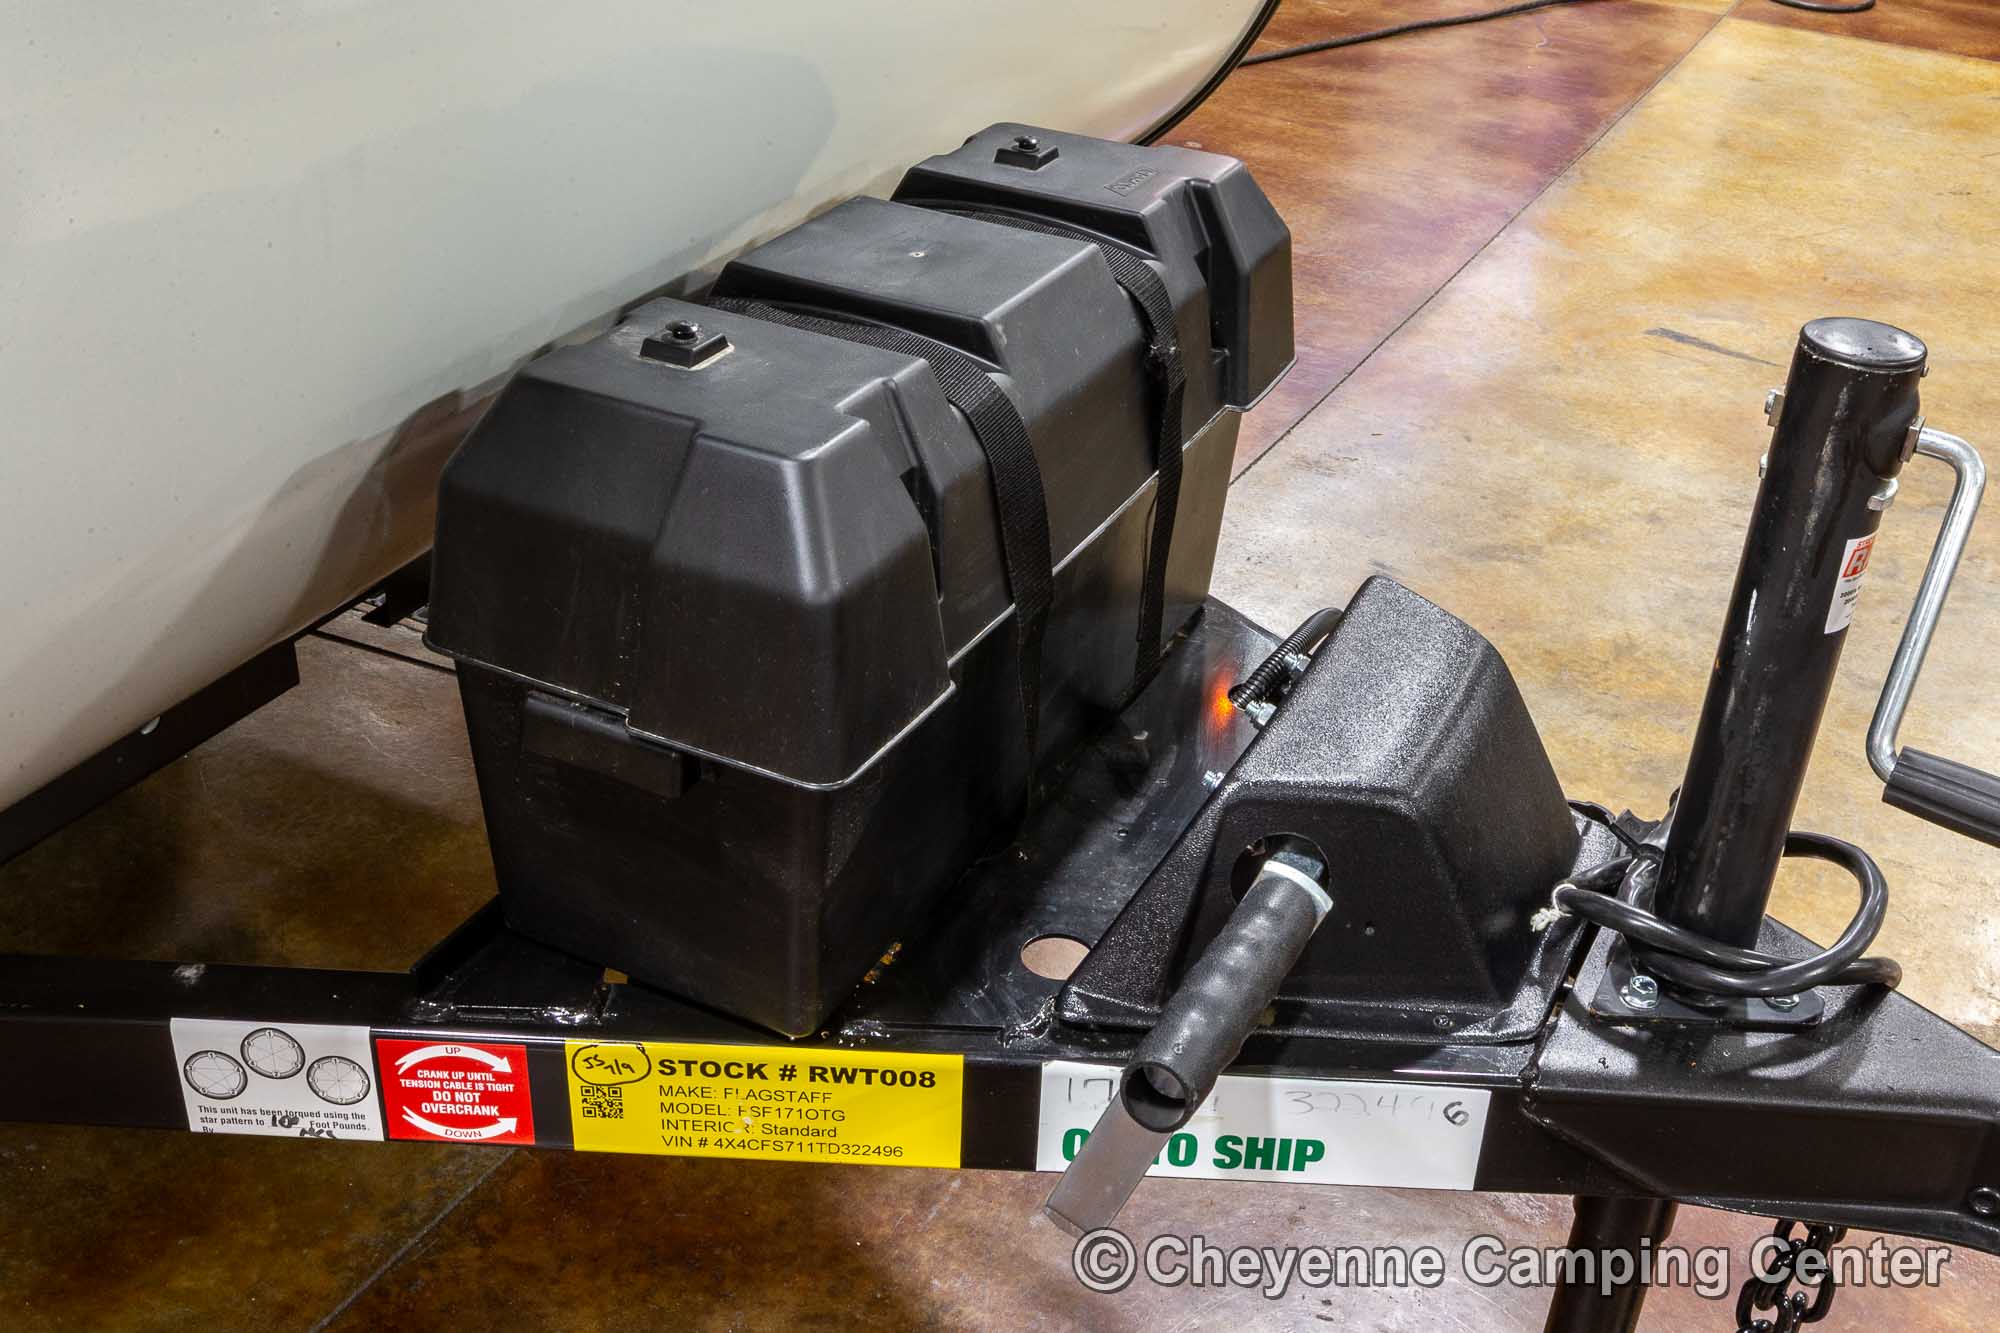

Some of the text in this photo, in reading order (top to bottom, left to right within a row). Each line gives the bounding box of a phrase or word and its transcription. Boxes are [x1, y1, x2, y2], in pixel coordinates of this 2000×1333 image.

[417, 1069, 495, 1082] CRANK UP UNTIL
[658, 1059, 936, 1088] STOCK # RWT008
[400, 1079, 515, 1092] TENSION CABLE IS TIGHT
[659, 1085, 716, 1099] MAKE:
[433, 1091, 480, 1103] DO NOT
[198, 1105, 366, 1121] This unit has been torqued using the
[421, 1103, 500, 1116] OVERCRANK
[660, 1102, 730, 1116] MODEL:
[200, 1115, 265, 1127] star pattern to
[310, 1120, 331, 1129] Foot
[444, 1129, 482, 1138] DOWN
[762, 1123, 837, 1138] Standard
[662, 1135, 903, 1157] VIN # 4X4CFS711TD322496
[1212, 1134, 1326, 1172] SHIP
